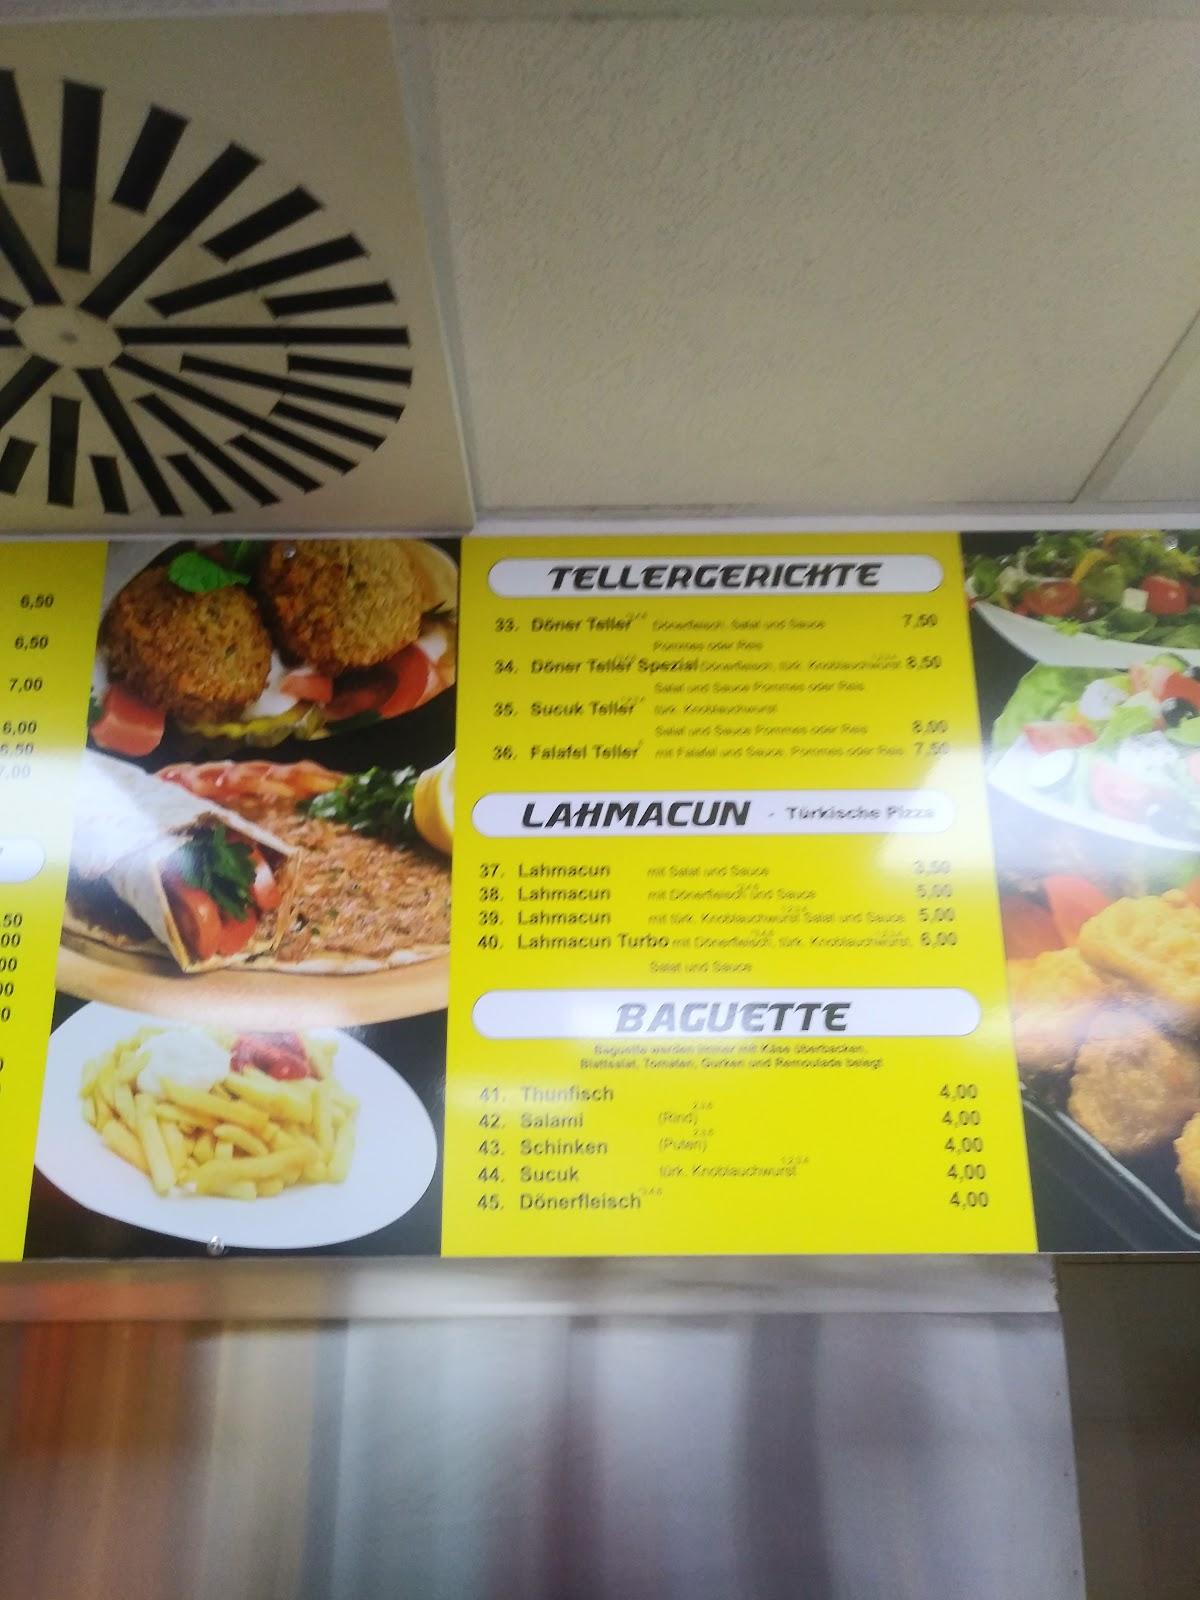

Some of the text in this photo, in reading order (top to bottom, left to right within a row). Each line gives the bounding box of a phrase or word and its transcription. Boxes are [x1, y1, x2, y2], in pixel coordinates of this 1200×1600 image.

[547, 563, 883, 591] TELLERGERICHTE
[20, 593, 54, 609] 6,50
[495, 616, 519, 632] 33.
[530, 616, 581, 632] Döner
[587, 615, 631, 632] Teller
[903, 613, 938, 628] 7,50
[14, 635, 49, 651] 6,50
[494, 658, 518, 674] 34.
[530, 657, 581, 674] Döner
[588, 657, 632, 674] Teller
[638, 656, 698, 676] Spezial
[9, 677, 44, 693] 7,00
[494, 702, 518, 718] 35.
[530, 700, 582, 717] Sucuk
[589, 700, 634, 717] Teller
[3, 720, 37, 736] 6,00
[493, 744, 516, 760] 36.
[529, 743, 587, 760] Falafel
[594, 744, 640, 760] Teller
[520, 800, 752, 828] LAHMACUN
[787, 805, 881, 821] Türkische
[887, 804, 936, 819] Pizza
[479, 863, 503, 879] 37.
[518, 863, 610, 879] Lahmacun
[479, 886, 503, 902] 38.
[518, 886, 610, 902] Lahmacun
[479, 910, 503, 926] 39.
[518, 909, 611, 926] Lahmacun
[918, 907, 955, 924] 5,00
[478, 934, 503, 951] 40.
[518, 933, 611, 950] Lahmacun
[618, 933, 669, 949] Turbo
[615, 1001, 852, 1033] BAGUETTE
[479, 1083, 978, 1102] 41. Thunfisch 4,00
[478, 1112, 505, 1129] 42.
[521, 1112, 584, 1128] Salami
[942, 1110, 980, 1128] 4,00
[478, 1139, 505, 1155] 43.
[521, 1137, 608, 1156] Schinken
[944, 1137, 983, 1155] 4,00
[478, 1166, 505, 1183] 44.
[520, 1165, 579, 1182] Sucuk
[947, 1164, 986, 1182] 4,00
[477, 1191, 989, 1210] 45. Dönerfleisch 4,00
